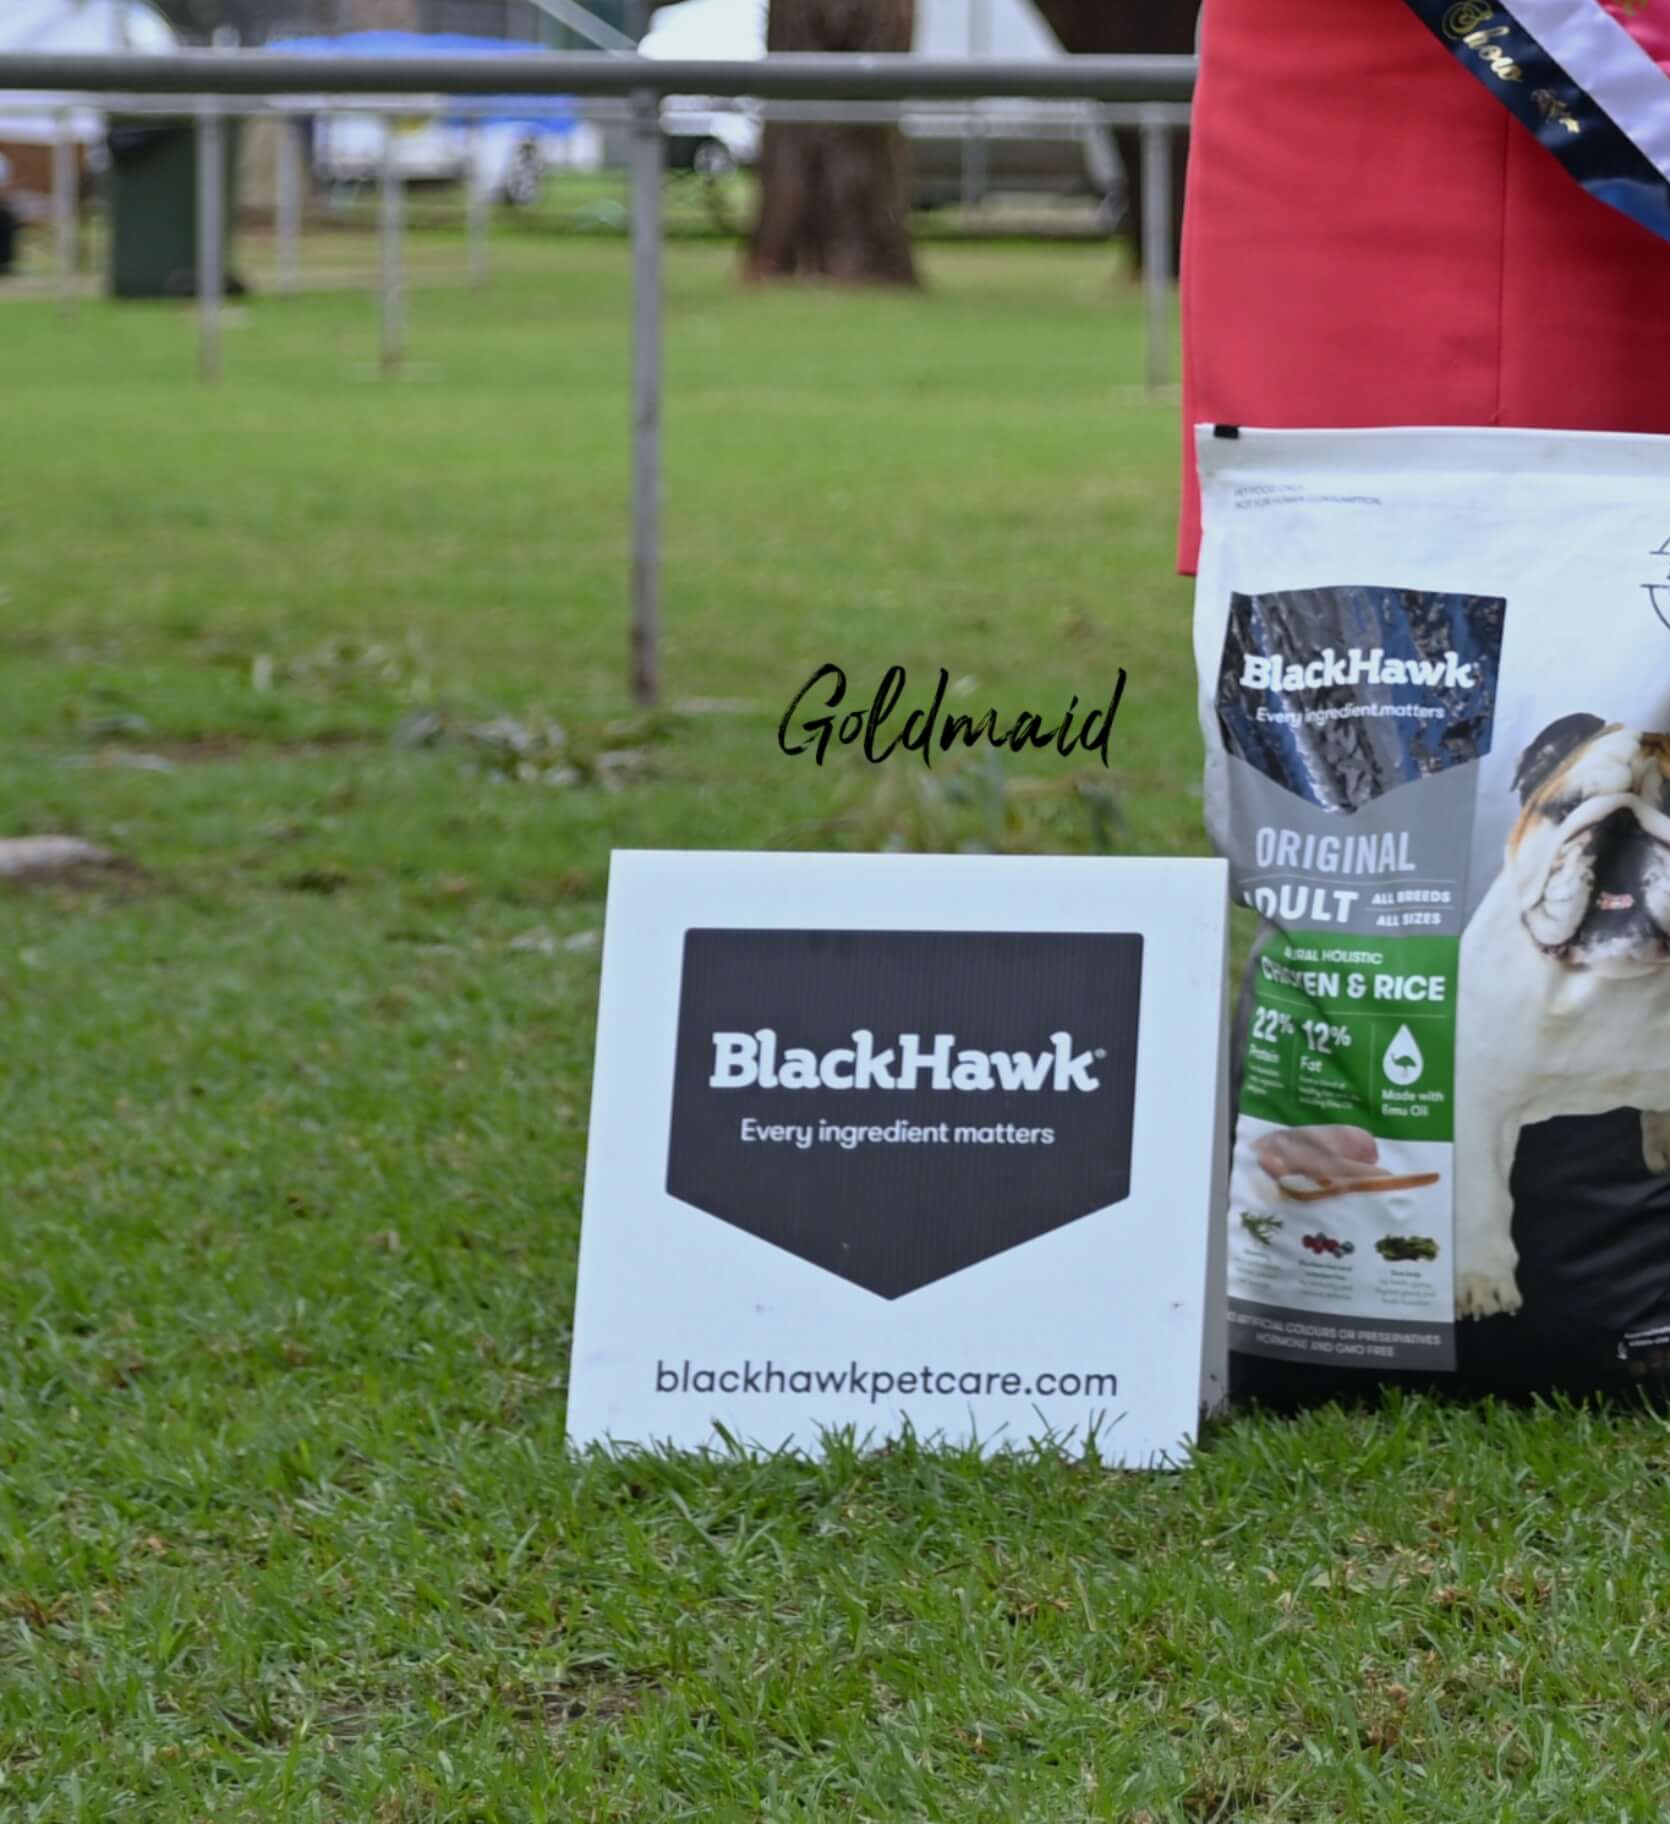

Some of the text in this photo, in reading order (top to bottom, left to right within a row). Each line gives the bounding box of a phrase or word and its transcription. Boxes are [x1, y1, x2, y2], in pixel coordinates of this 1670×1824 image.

[1240, 648, 1476, 693] BlackHawk
[1255, 702, 1445, 726] Every ingredient matters
[1255, 826, 1416, 875] ORIGINAL
[1244, 884, 1360, 923] DULT
[1371, 889, 1451, 905] ALL BREEDS
[1375, 912, 1442, 927] ALL SIZES
[1321, 949, 1384, 965] HOLISTIC
[1347, 972, 1367, 999] &
[1374, 973, 1447, 1002] RICE
[1301, 1019, 1353, 1055] 12%
[709, 1028, 1100, 1092] BlackHawk
[1299, 1056, 1323, 1073] Fat
[1381, 1089, 1445, 1102] Made with
[1381, 1104, 1430, 1118] Emu Oil
[740, 1117, 1056, 1149] Every ingredient matters
[654, 1359, 1119, 1403] blackhawkpetcare.com
